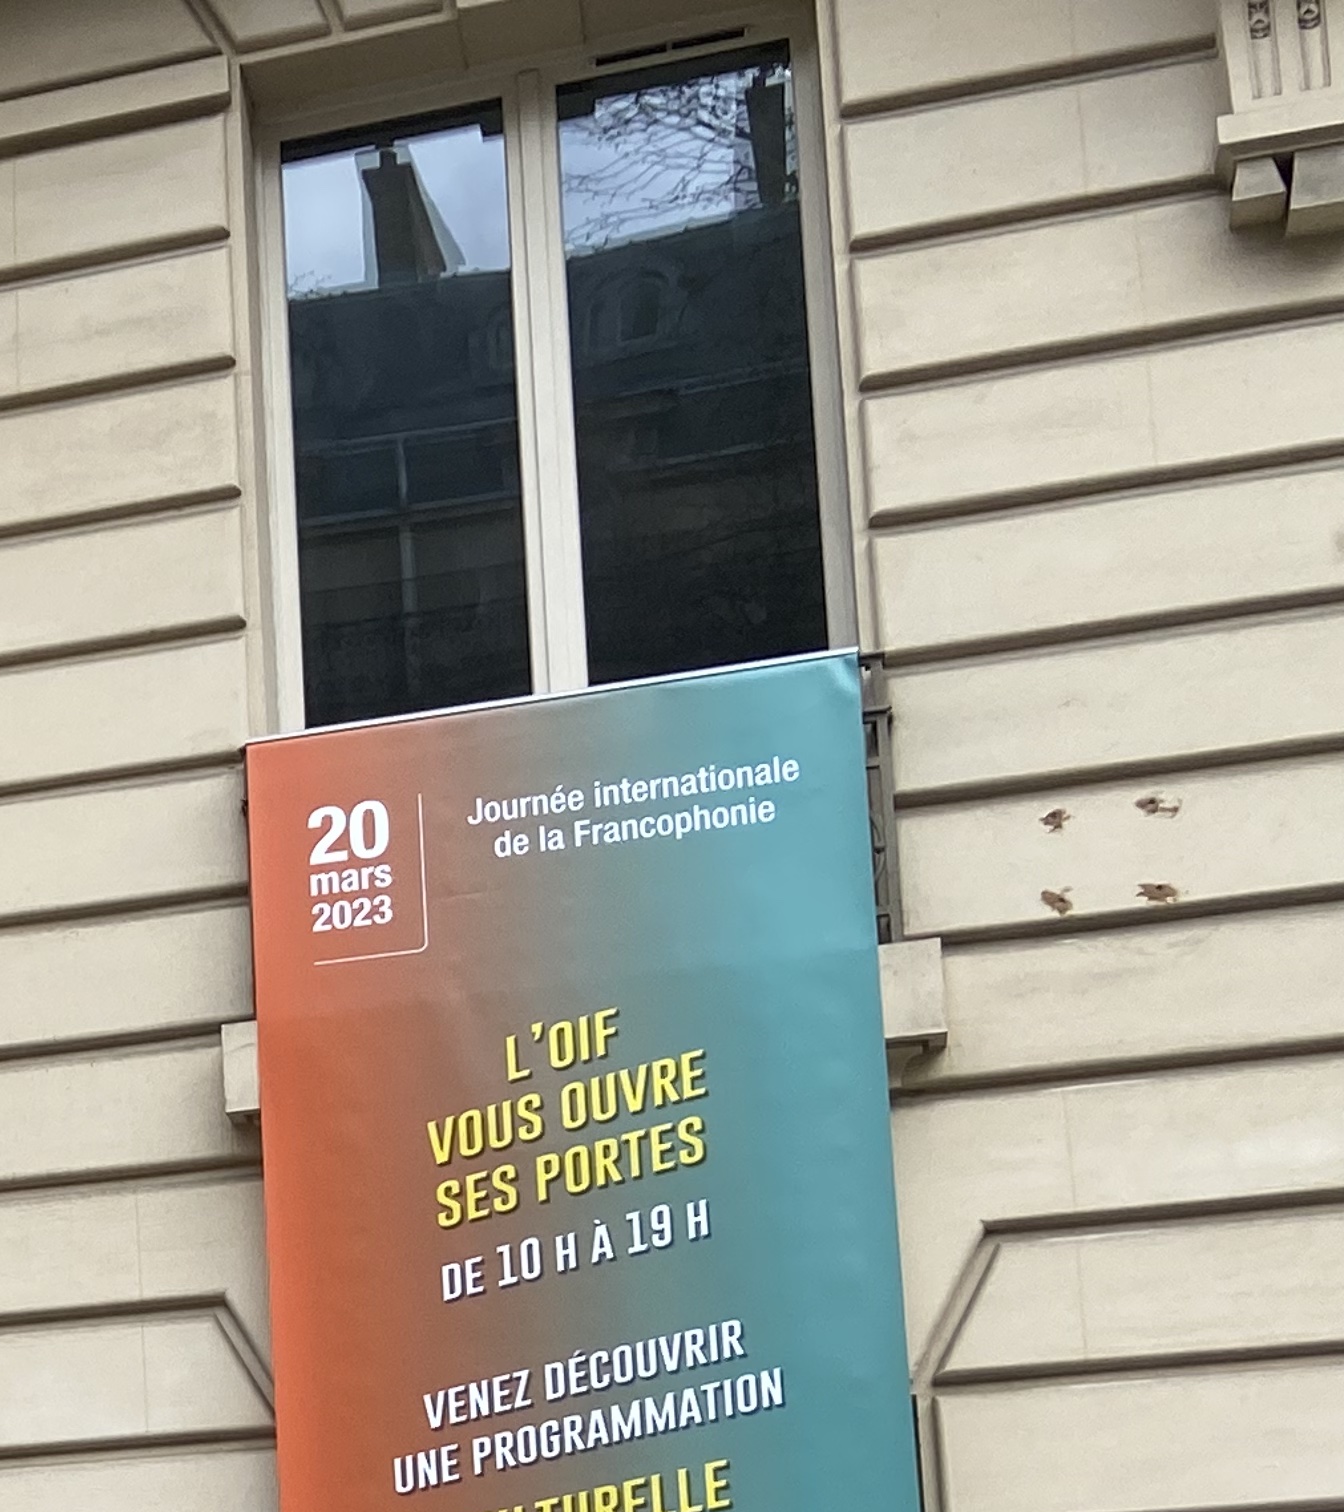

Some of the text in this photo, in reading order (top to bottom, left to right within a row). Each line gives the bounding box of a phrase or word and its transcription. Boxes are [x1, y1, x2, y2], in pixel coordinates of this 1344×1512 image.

[306, 800, 390, 865] 20
[467, 756, 800, 825] Journée internationale
[494, 798, 776, 857] de la Francophonie
[309, 861, 393, 897] mars
[311, 895, 394, 932] 2023
[427, 1049, 708, 1165] VOUS OUVRE
[436, 1116, 705, 1229] SES PORTES
[441, 1199, 710, 1302] DE 10 H À 19 H
[422, 1319, 745, 1429] VENEZ DÉCOUVRIR
[393, 1366, 784, 1494] UNE PROGRAMMATION
